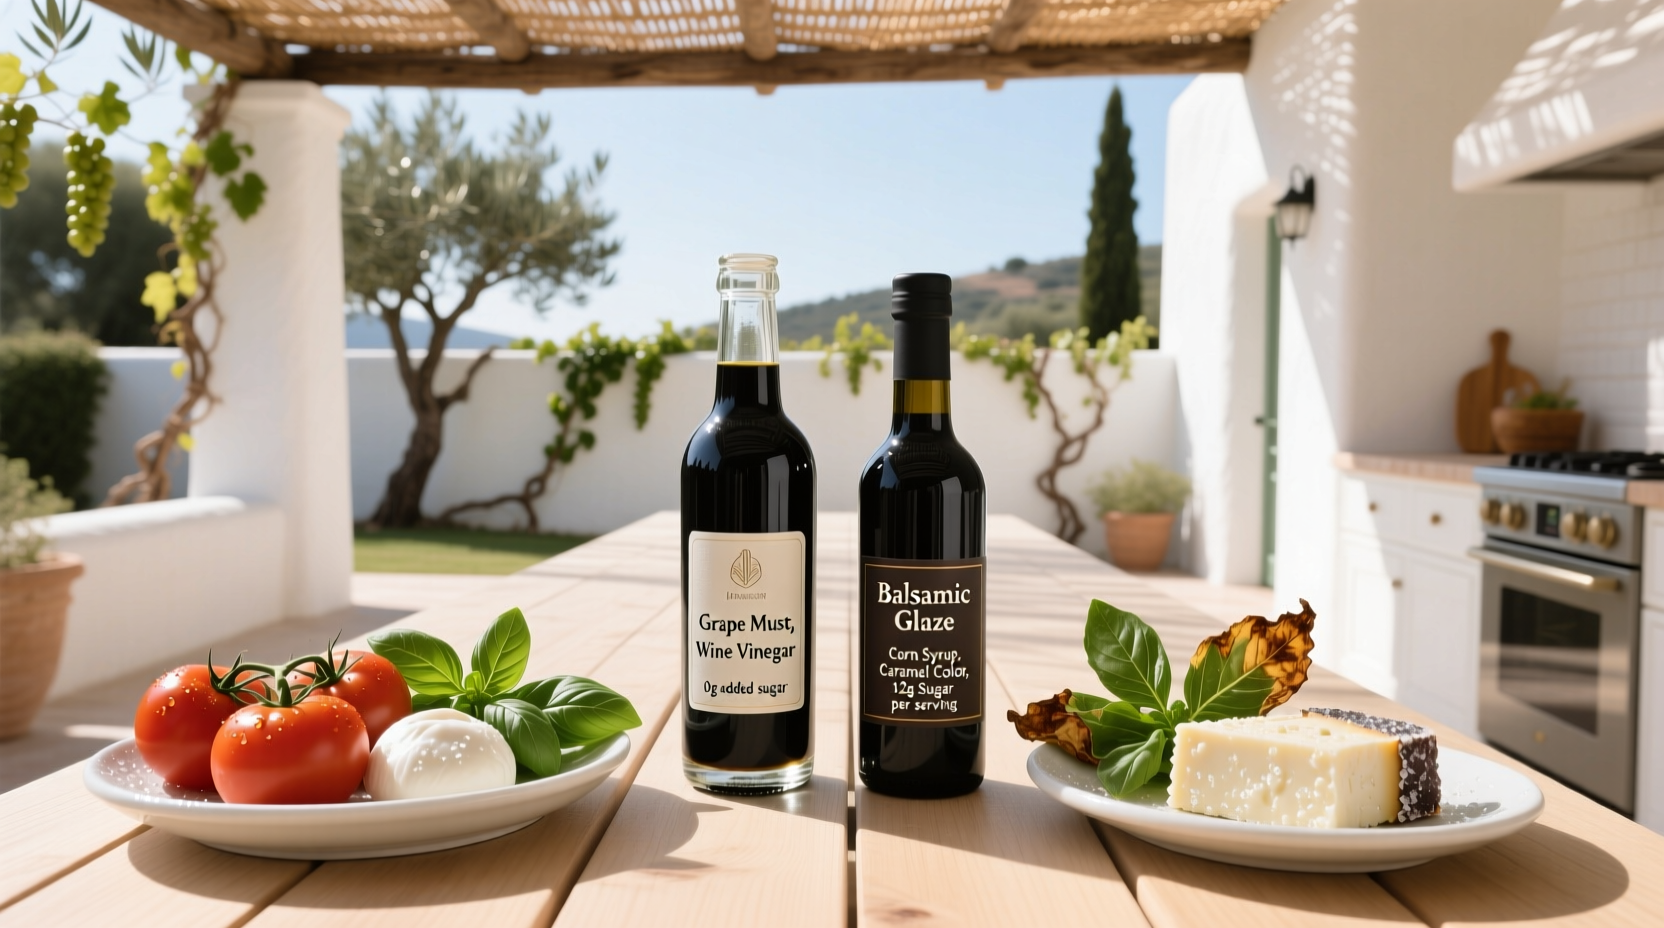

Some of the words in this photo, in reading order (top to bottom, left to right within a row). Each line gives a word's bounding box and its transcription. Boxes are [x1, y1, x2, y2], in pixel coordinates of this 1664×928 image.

[877, 581, 971, 605] Balsamic
[699, 613, 746, 637] Grape
[750, 614, 795, 634] Must,
[894, 609, 955, 632] Glaze
[695, 640, 733, 659] Wine
[736, 642, 796, 664] Vinegar
[888, 646, 919, 661] Corn
[879, 663, 929, 678] Caramel
[933, 664, 970, 679] Color,
[704, 680, 718, 697] 0g
[720, 681, 754, 695] added
[757, 682, 788, 697] sugar
[893, 681, 915, 698] 12g
[918, 682, 954, 699] Sugar
[891, 699, 911, 714] per
[914, 699, 958, 712] serving
